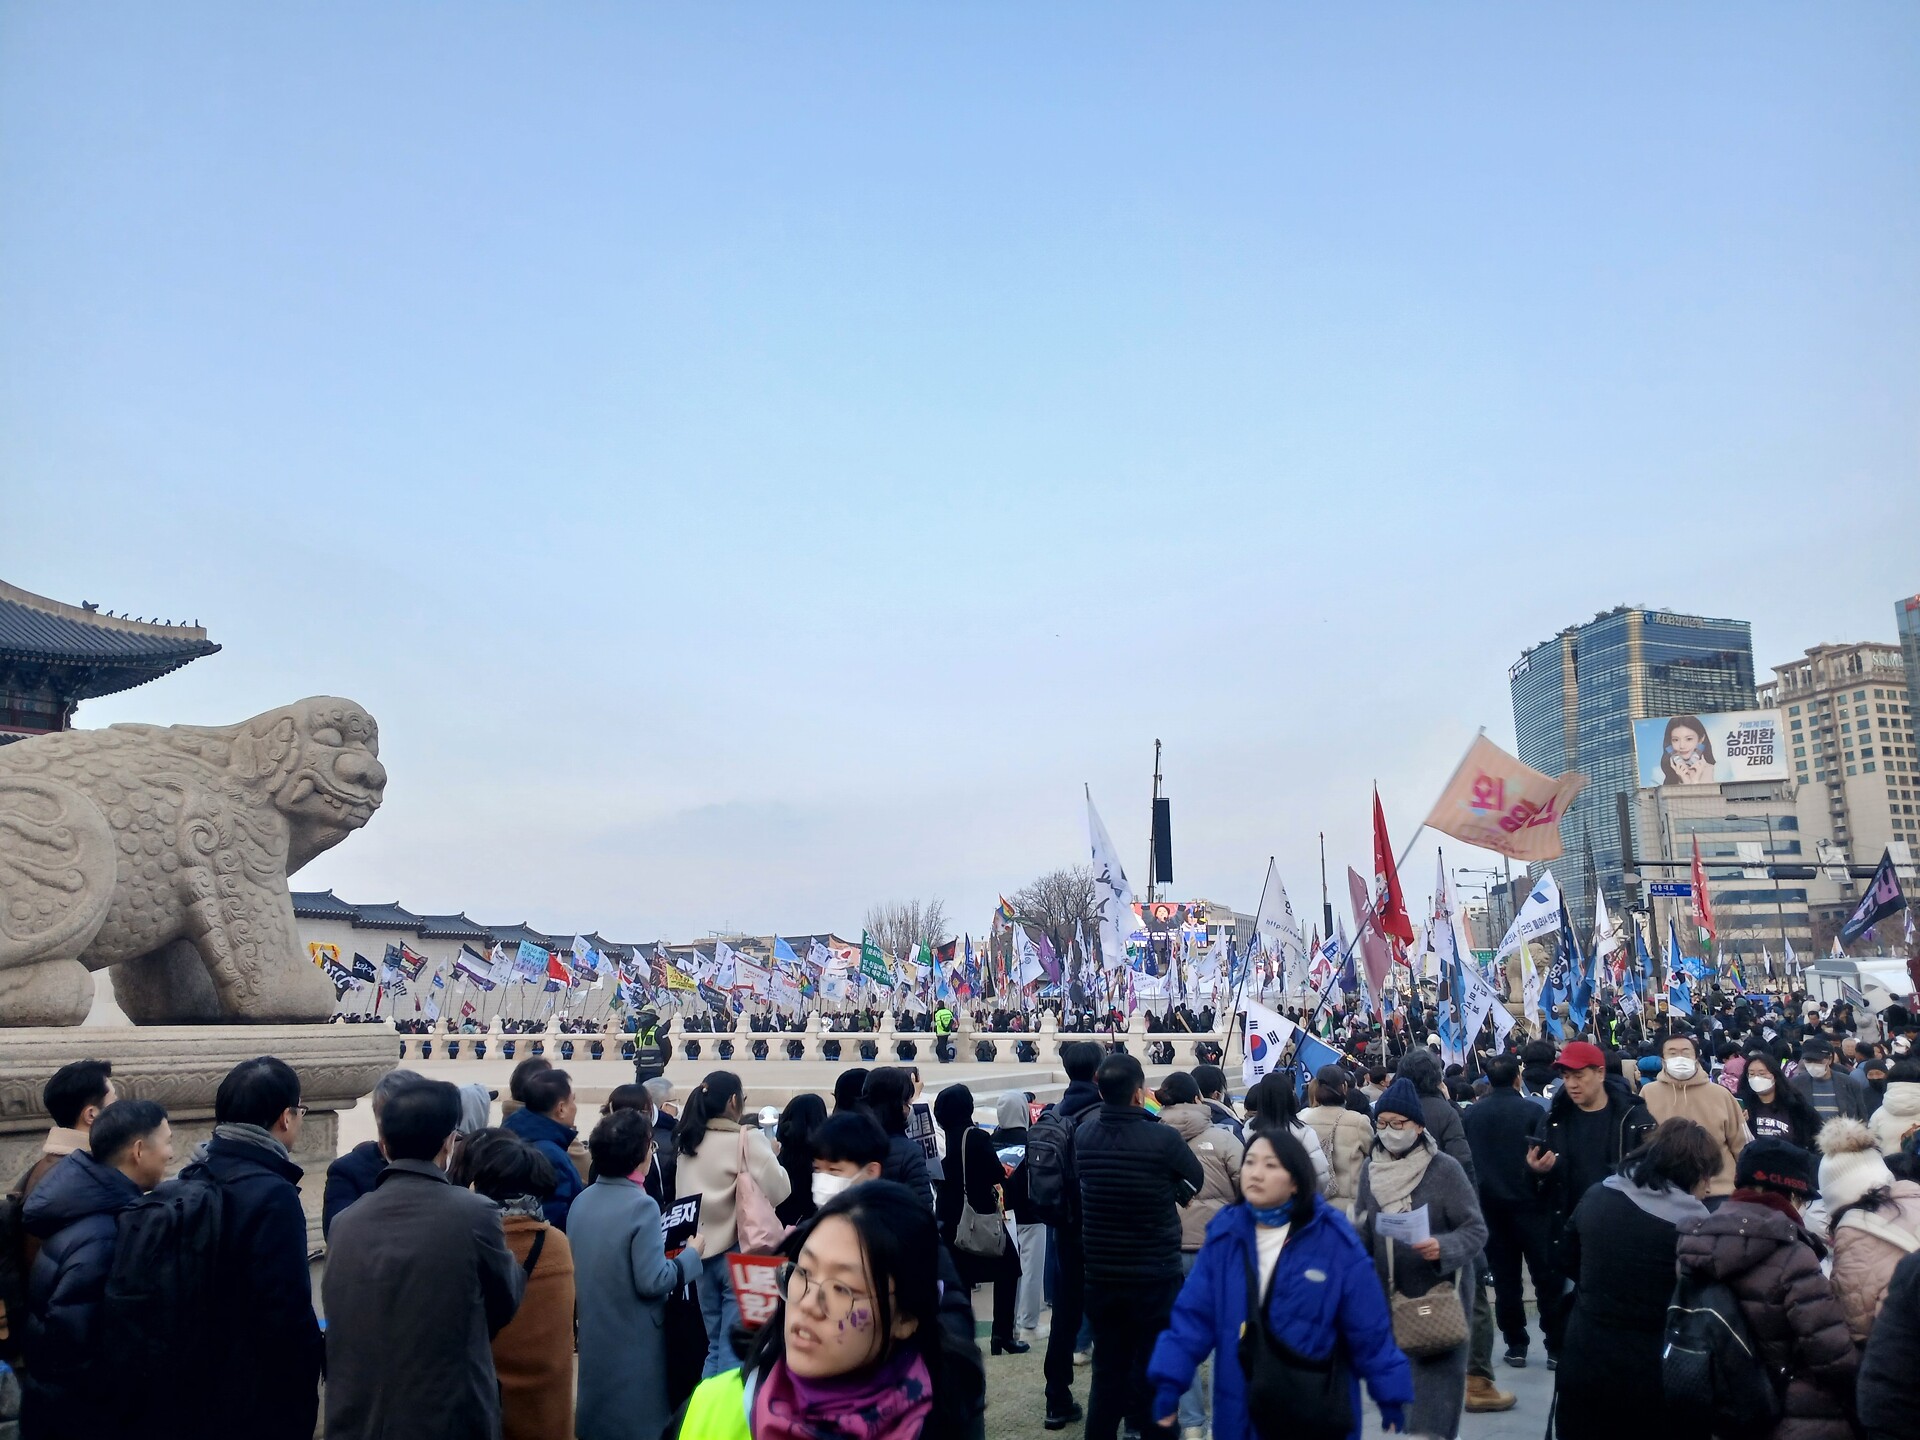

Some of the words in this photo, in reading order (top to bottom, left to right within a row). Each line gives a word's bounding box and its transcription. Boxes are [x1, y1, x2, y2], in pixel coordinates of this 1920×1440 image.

[1726, 728, 1775, 746] 상쾌환
[1727, 744, 1773, 757] BOOSTER
[1747, 755, 1773, 766] ZERO
[661, 1201, 697, 1230] 노동자
